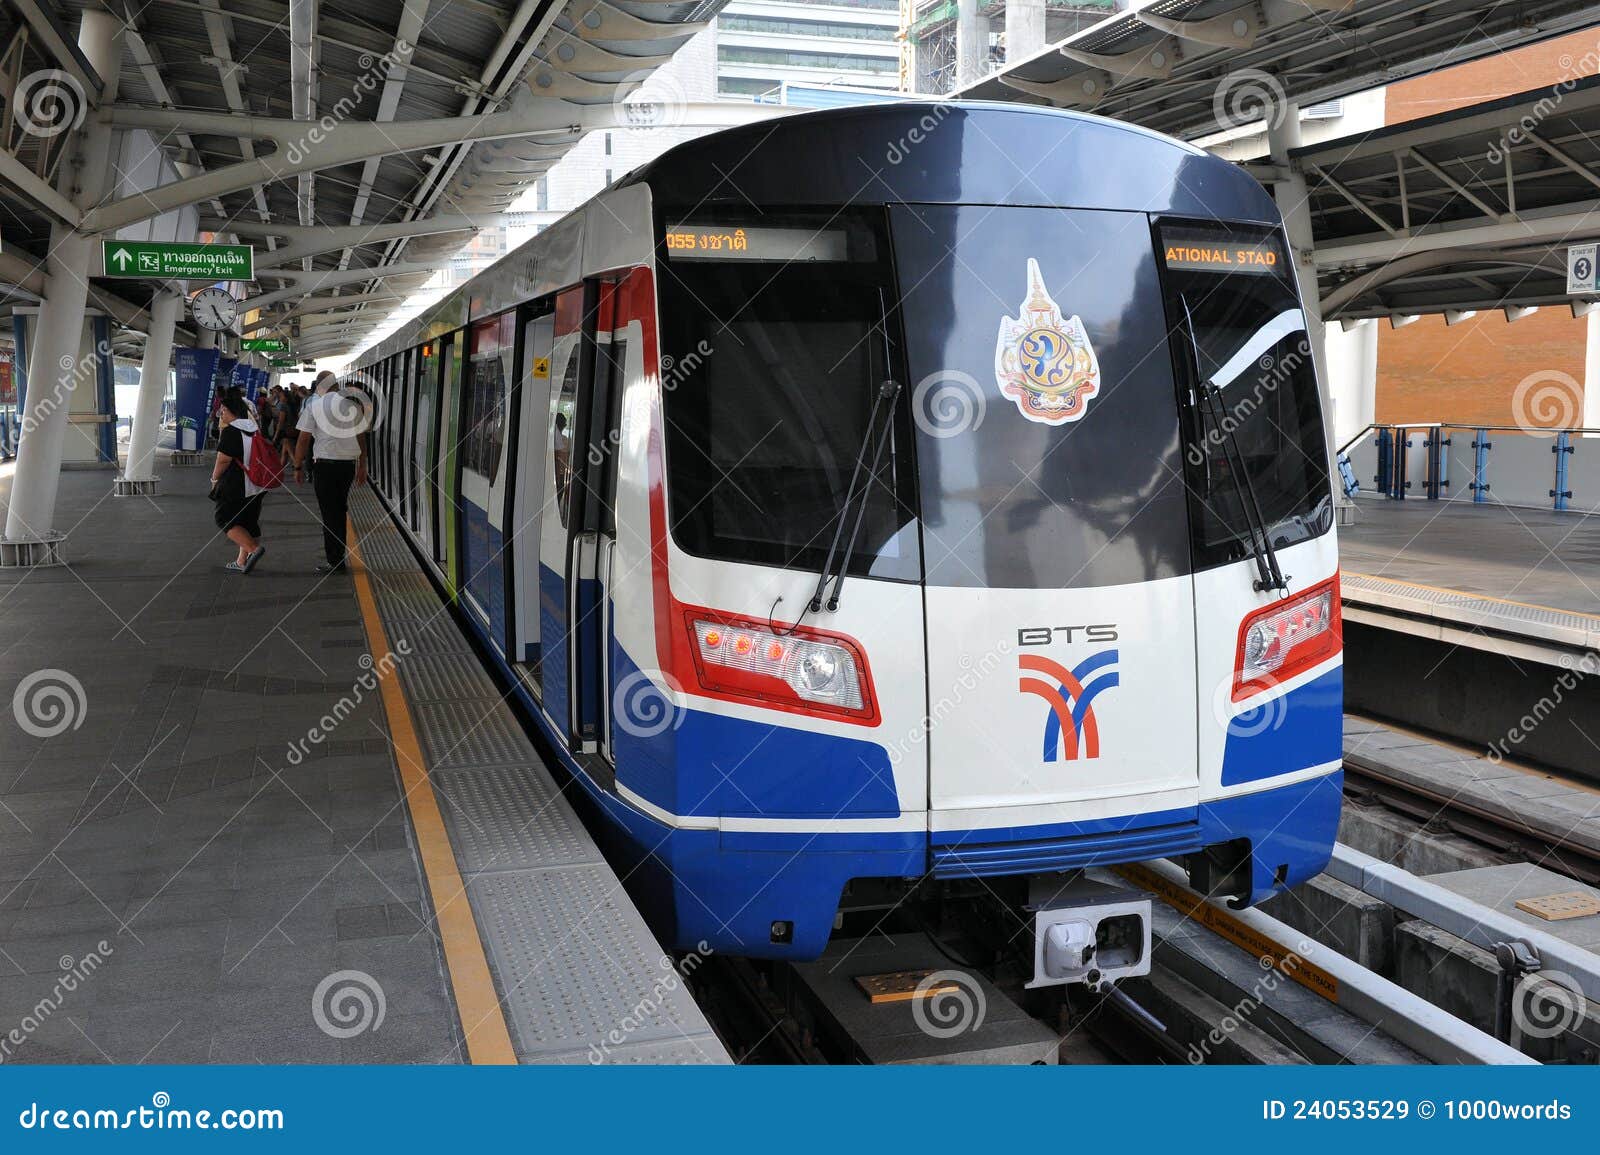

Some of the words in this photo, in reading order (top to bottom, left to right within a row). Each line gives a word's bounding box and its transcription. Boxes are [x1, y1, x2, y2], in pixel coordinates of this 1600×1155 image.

[162, 251, 245, 268] ทางออกฉุกเฉิน
[1166, 247, 1231, 263] ATIONAL
[1237, 250, 1276, 266] STAD
[164, 264, 213, 275] Emergency
[215, 266, 233, 275] Exit
[1017, 624, 1118, 646] BTS
